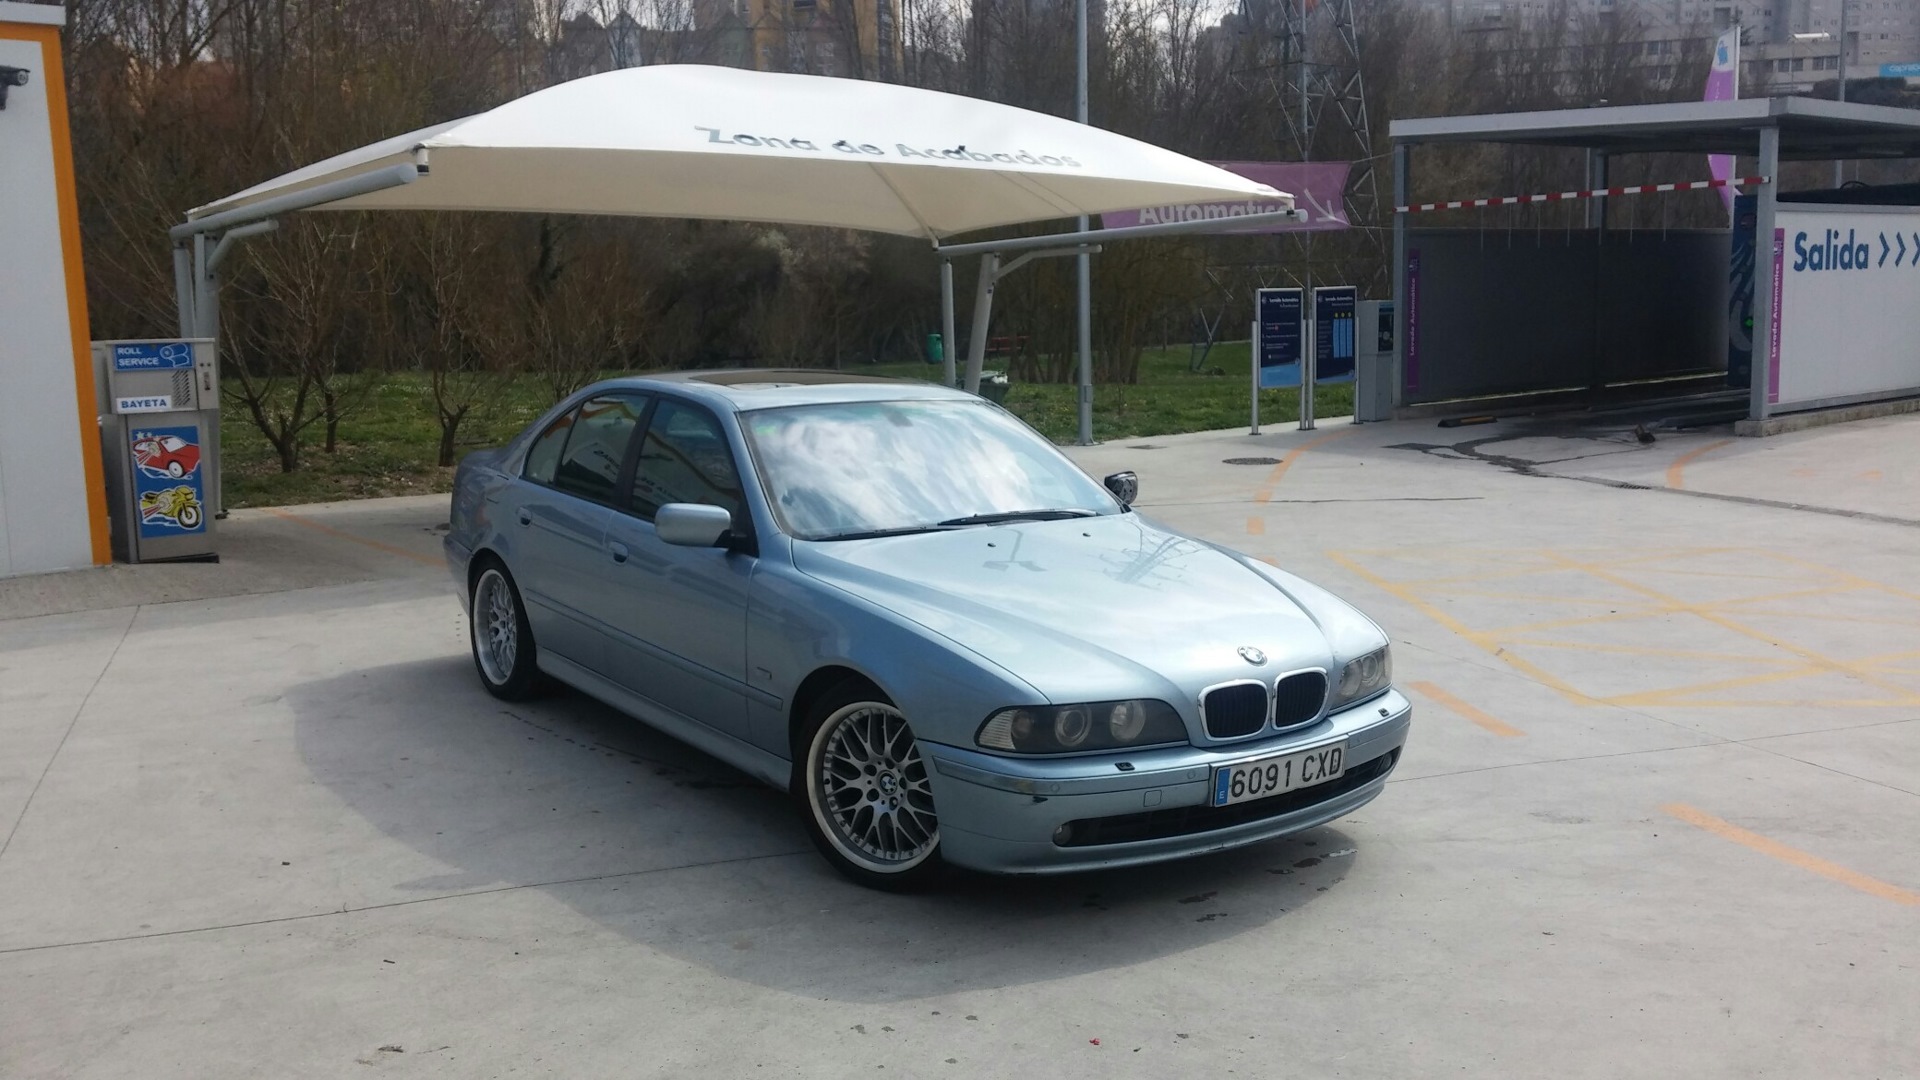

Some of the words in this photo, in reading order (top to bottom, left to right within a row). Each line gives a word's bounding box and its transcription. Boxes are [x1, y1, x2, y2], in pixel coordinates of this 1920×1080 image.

[695, 125, 821, 151] Zona
[831, 139, 885, 156] de
[895, 143, 1082, 168] Acabados
[1793, 228, 1869, 272] Salida
[117, 347, 142, 355] ROLL
[118, 357, 160, 367] SERVICE
[120, 398, 168, 409] BAYETA
[1231, 760, 1292, 798] 6091
[1302, 747, 1342, 783] CXD
[1219, 791, 1226, 800] E
